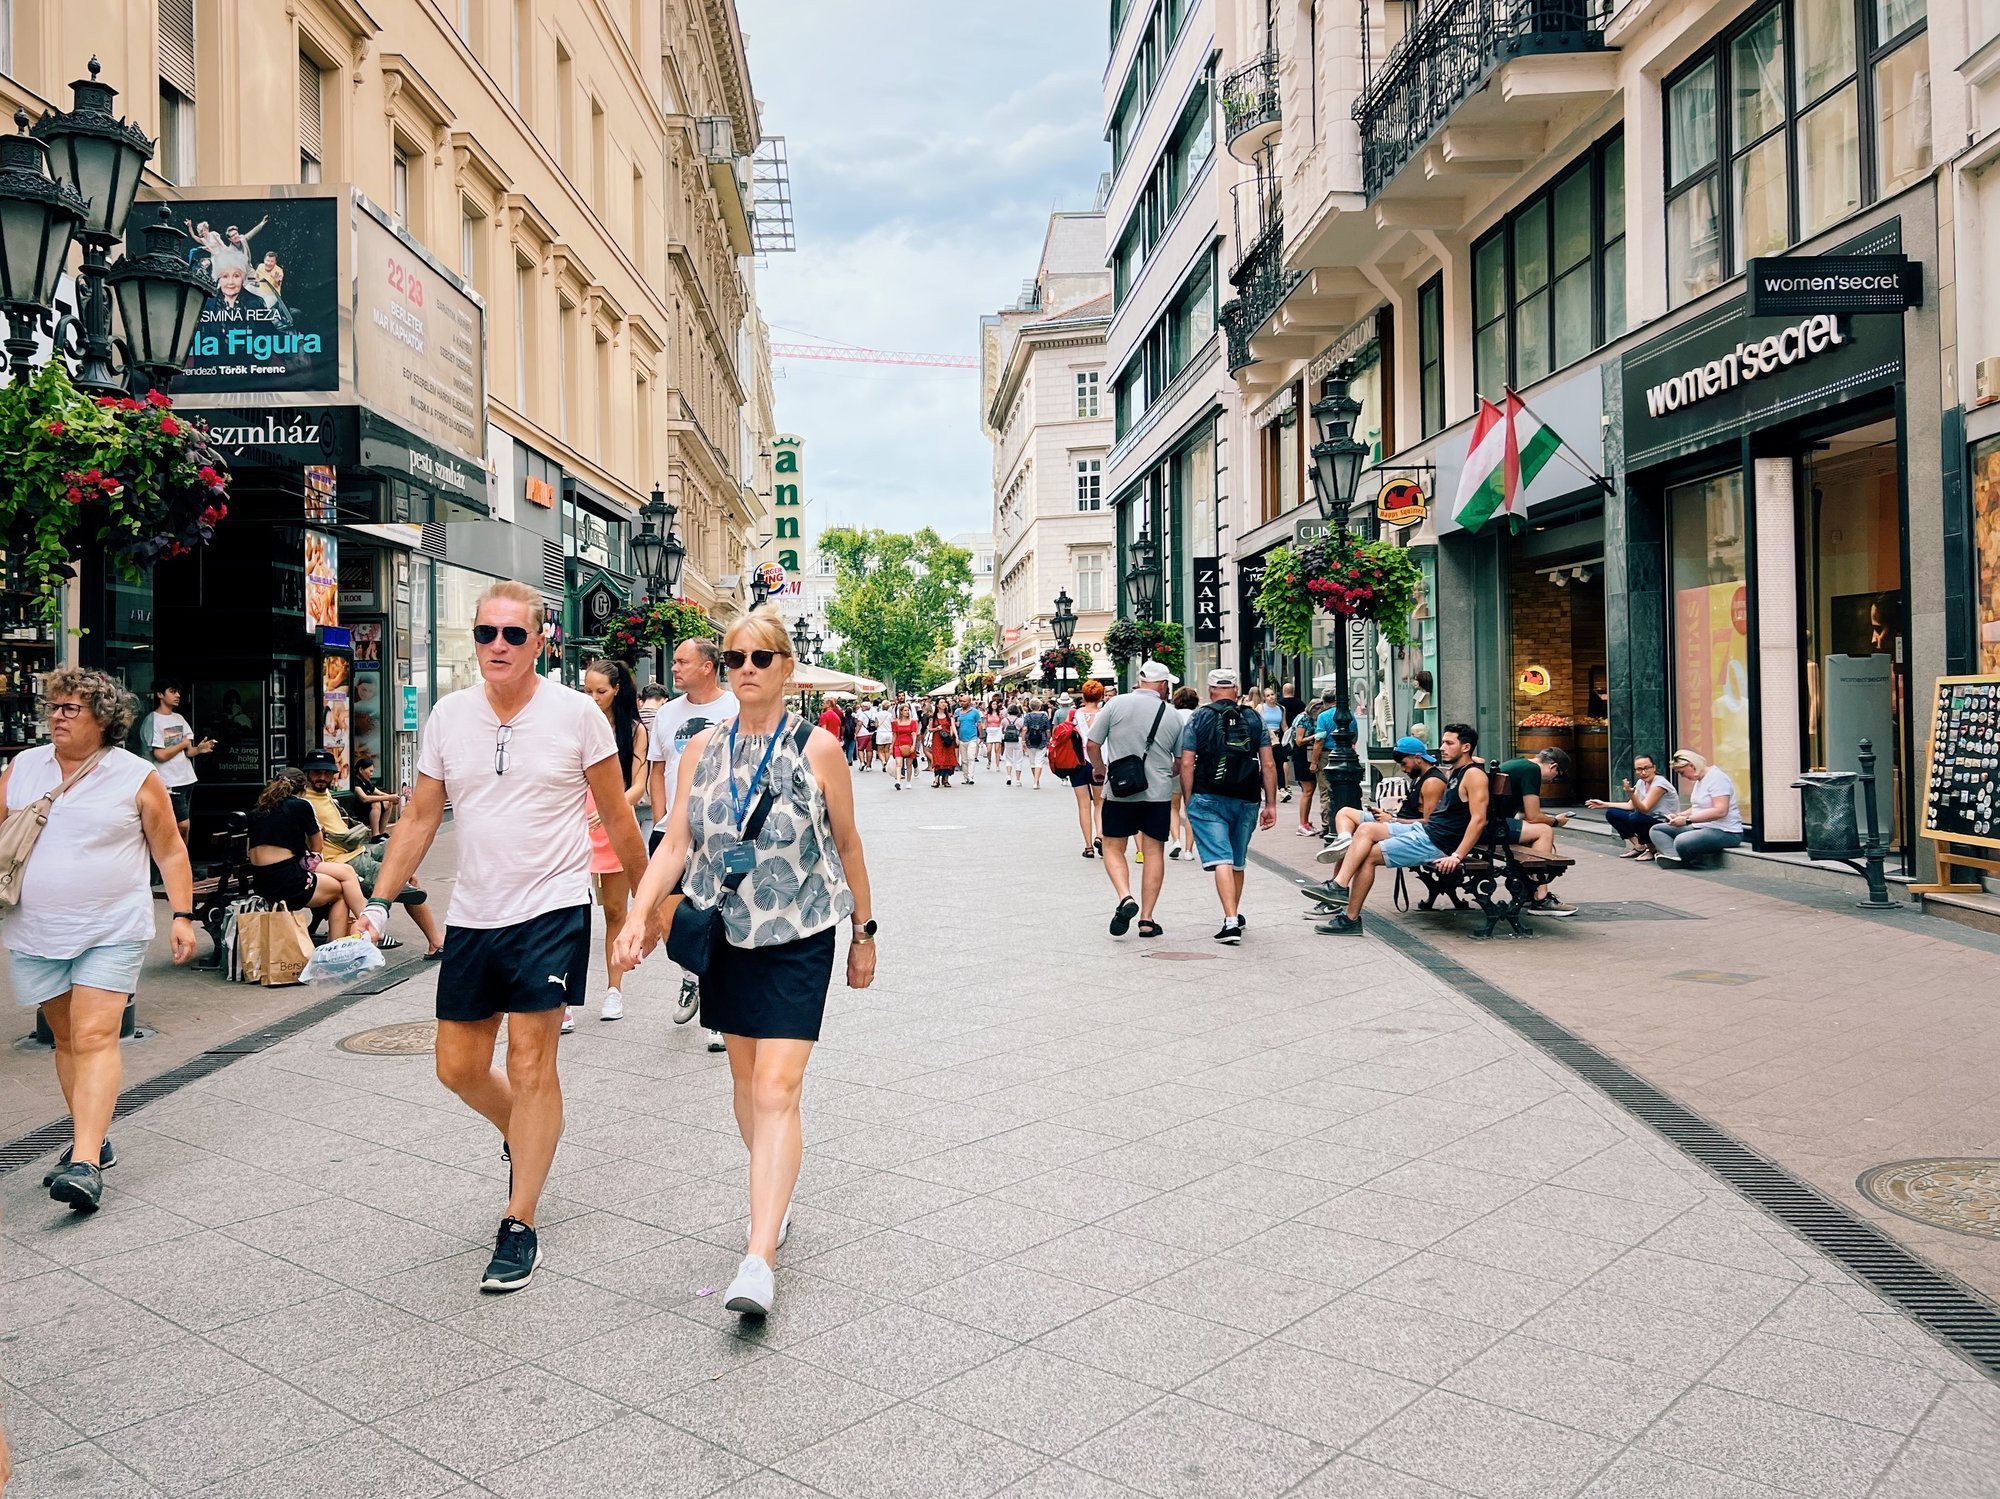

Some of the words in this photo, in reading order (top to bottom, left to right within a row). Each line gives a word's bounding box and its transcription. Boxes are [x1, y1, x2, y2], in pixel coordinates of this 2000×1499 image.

[1765, 273, 1899, 292] women'secret
[246, 308, 282, 321] REZA
[228, 329, 322, 360] Figura
[218, 365, 248, 375] Török
[250, 365, 286, 374] Ferenc
[1646, 313, 1843, 418] women'secret
[1379, 511, 1398, 519] Happy
[1400, 507, 1424, 516] Squirrel
[763, 573, 784, 583] ING
[1197, 570, 1217, 630] ZARA
